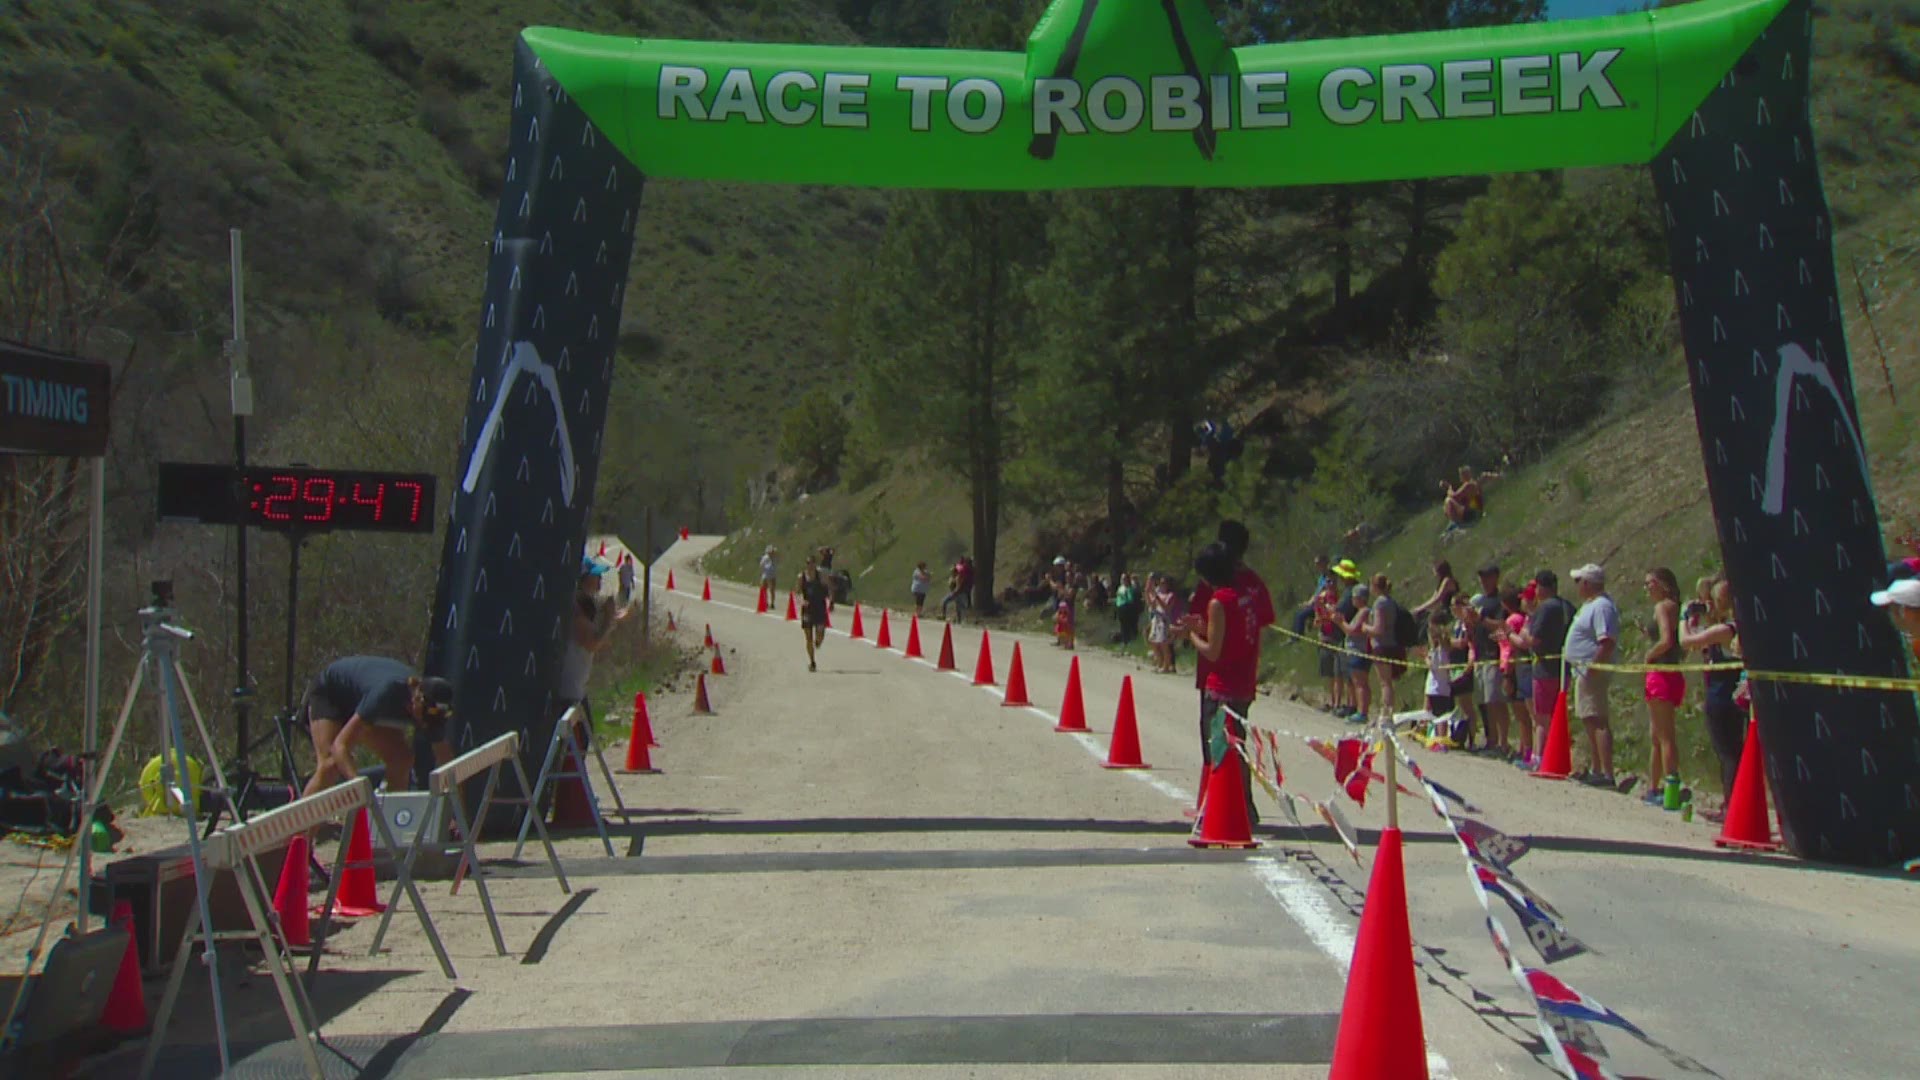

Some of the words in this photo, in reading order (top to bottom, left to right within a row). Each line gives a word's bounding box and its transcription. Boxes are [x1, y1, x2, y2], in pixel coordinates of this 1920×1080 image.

[656, 63, 871, 129] RACE
[896, 73, 1004, 134] TO
[1033, 72, 1291, 135] ROBIE
[1318, 47, 1626, 127] CREEK
[1, 373, 88, 425] TIMING
